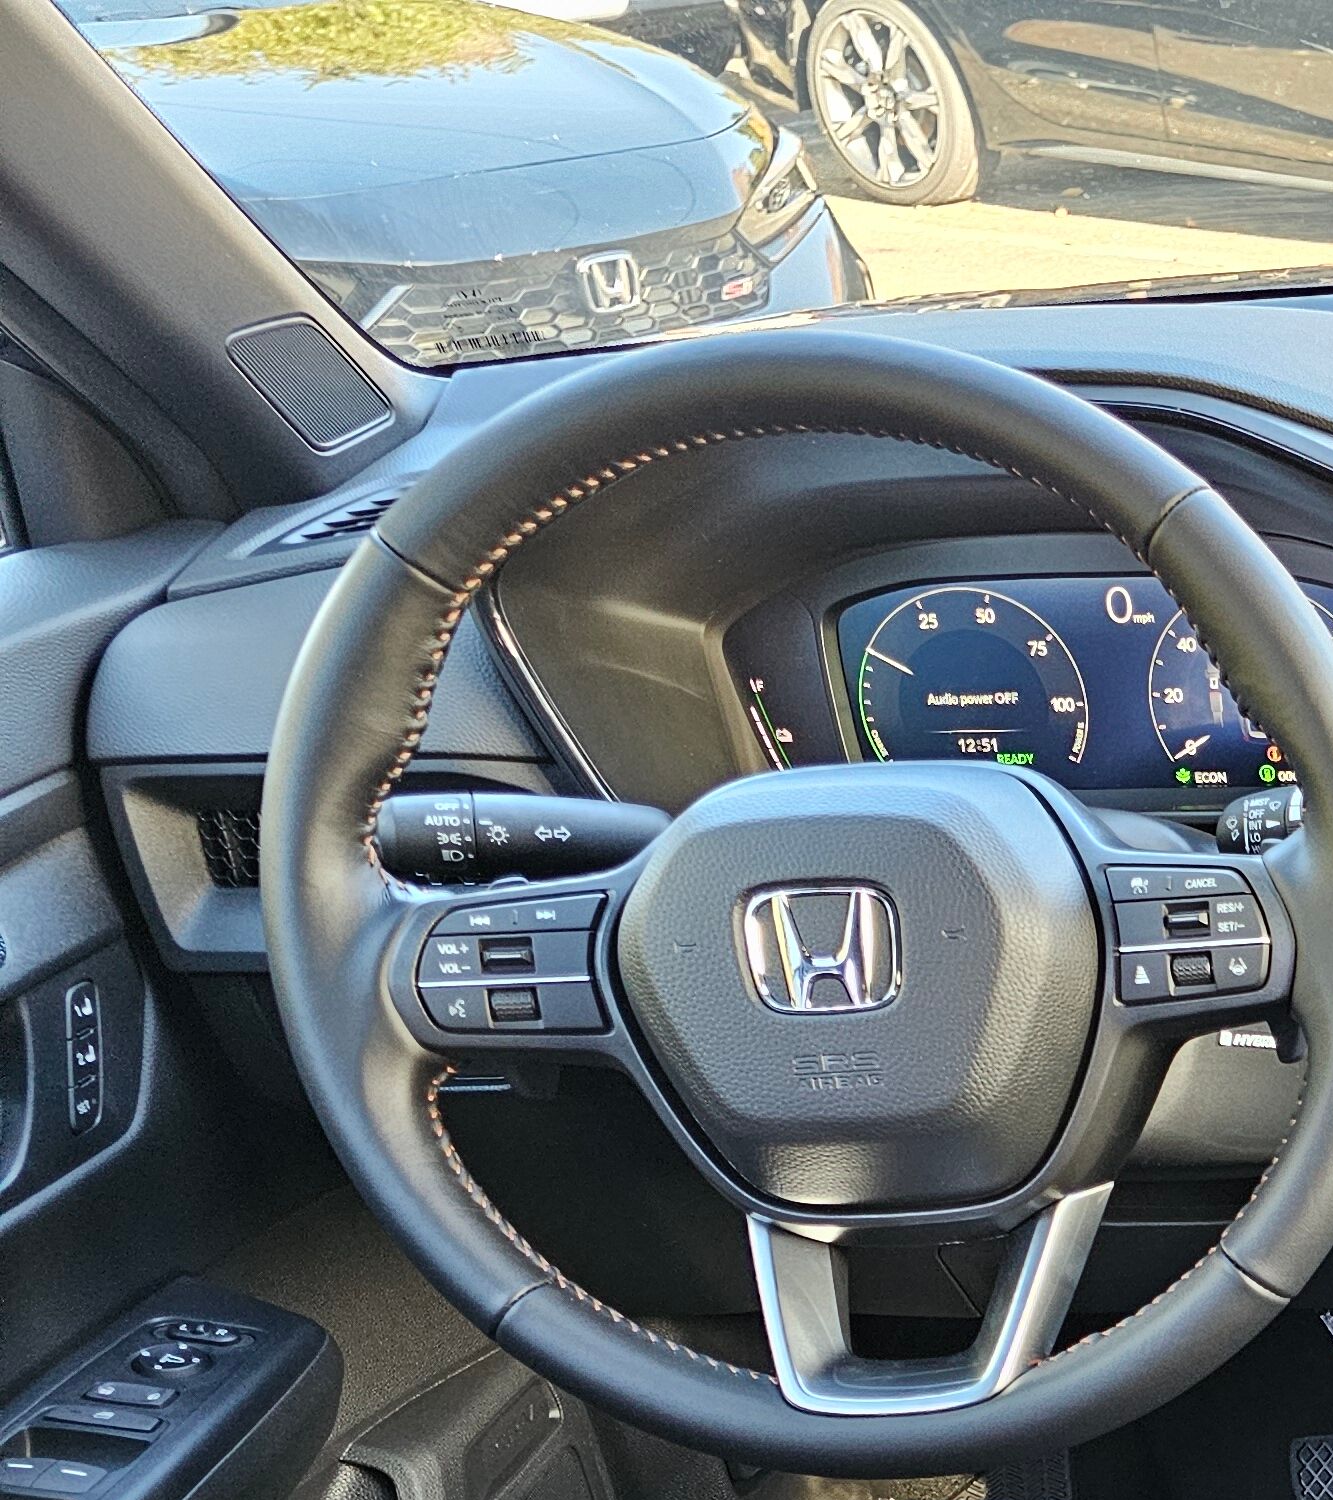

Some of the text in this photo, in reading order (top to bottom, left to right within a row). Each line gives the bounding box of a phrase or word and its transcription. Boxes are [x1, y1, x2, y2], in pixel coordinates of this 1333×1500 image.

[1105, 585, 1156, 625] 0 mph
[918, 612, 939, 630] 25
[975, 607, 996, 625] 50
[1026, 640, 1048, 657] 75
[1176, 636, 1197, 653] 40
[927, 691, 1019, 708] Audio power OFF
[1163, 687, 1184, 704] 20
[1050, 697, 1077, 713] 100
[957, 737, 999, 753] 12:51
[996, 753, 1035, 765] READY
[1194, 771, 1228, 784] ECON
[424, 815, 461, 827] AUTO
[1248, 808, 1265, 819] OFF
[1249, 820, 1263, 831] INT
[1249, 832, 1261, 843] LO
[1184, 878, 1218, 889] CANCEL
[792, 1050, 882, 1072] SRS
